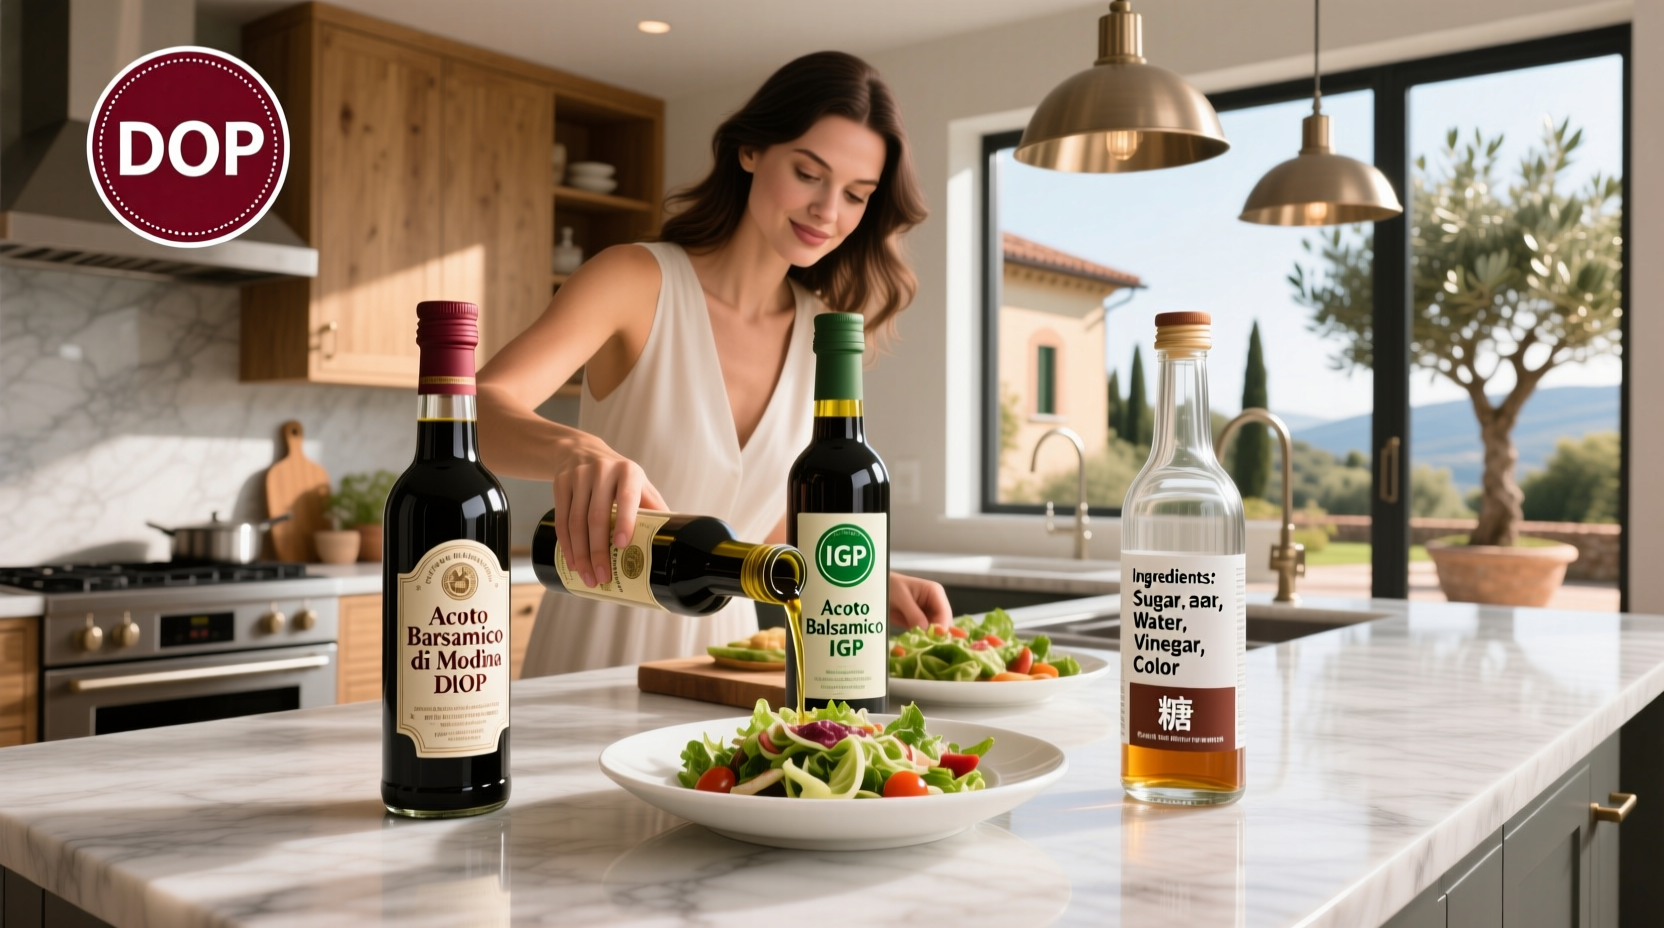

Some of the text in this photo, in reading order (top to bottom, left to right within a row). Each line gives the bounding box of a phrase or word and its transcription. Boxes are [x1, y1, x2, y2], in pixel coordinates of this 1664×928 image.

[826, 544, 867, 567] IGP
[1132, 567, 1216, 588] Ingredients:
[428, 605, 489, 626] Acoto
[820, 599, 870, 616] Acoto
[806, 618, 884, 636] Balsamico
[1133, 611, 1187, 634] Water,
[406, 625, 504, 647] Barsamico
[1134, 633, 1205, 658] Vinegar,
[829, 639, 864, 657] IGP
[410, 649, 502, 671] di Modina
[1133, 655, 1181, 676] Color
[433, 673, 488, 695] DIOP
[1158, 695, 1195, 732] 糖
